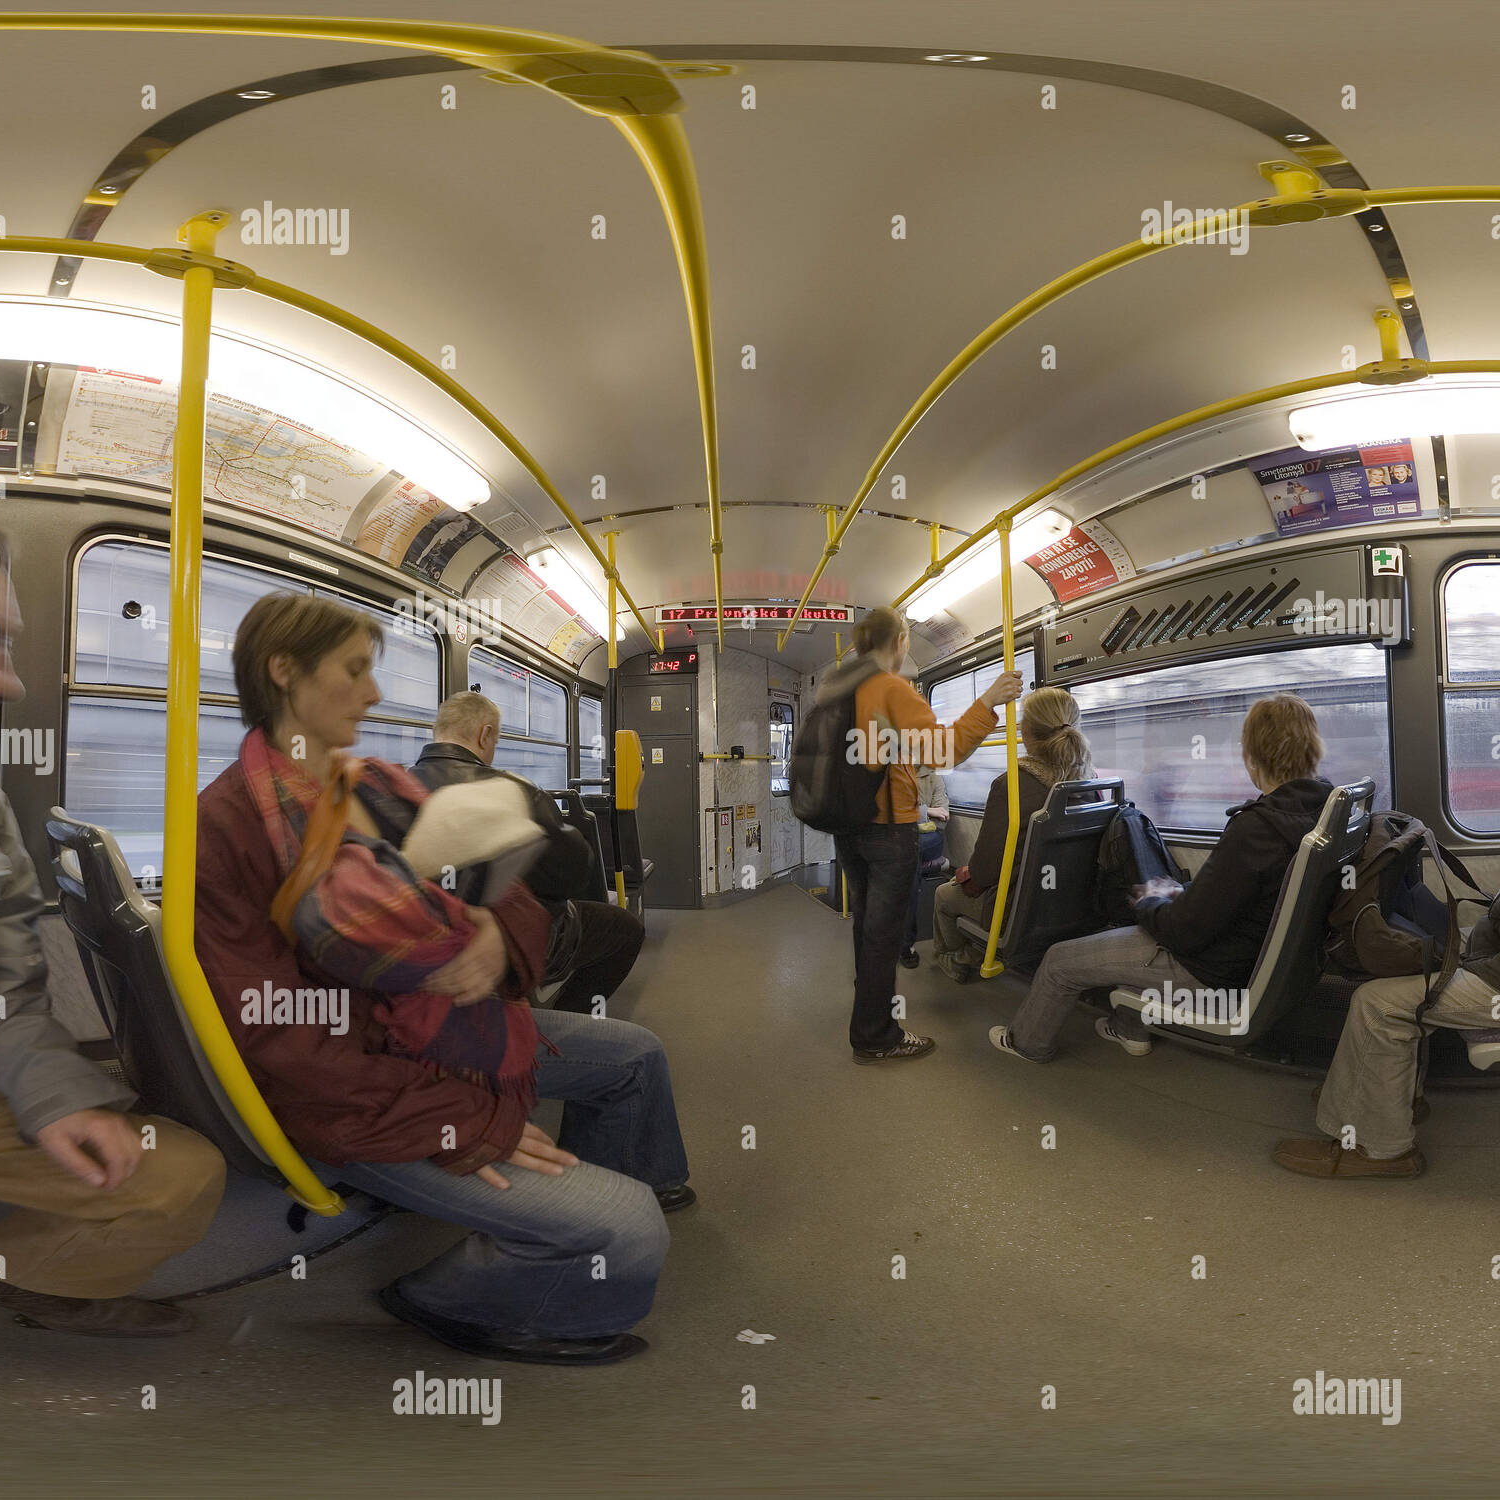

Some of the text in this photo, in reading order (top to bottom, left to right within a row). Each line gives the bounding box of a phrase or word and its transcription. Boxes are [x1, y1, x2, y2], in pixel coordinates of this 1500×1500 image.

[1260, 463, 1303, 478] Smetanova
[1274, 469, 1305, 481] Litomyšl
[1036, 548, 1054, 562] JEN
[1064, 536, 1079, 548] SE
[1039, 541, 1100, 574] KONKURENCE
[1059, 557, 1096, 581] ZAPOTÍ!
[668, 610, 684, 619] 17
[653, 661, 680, 671] 17:42
